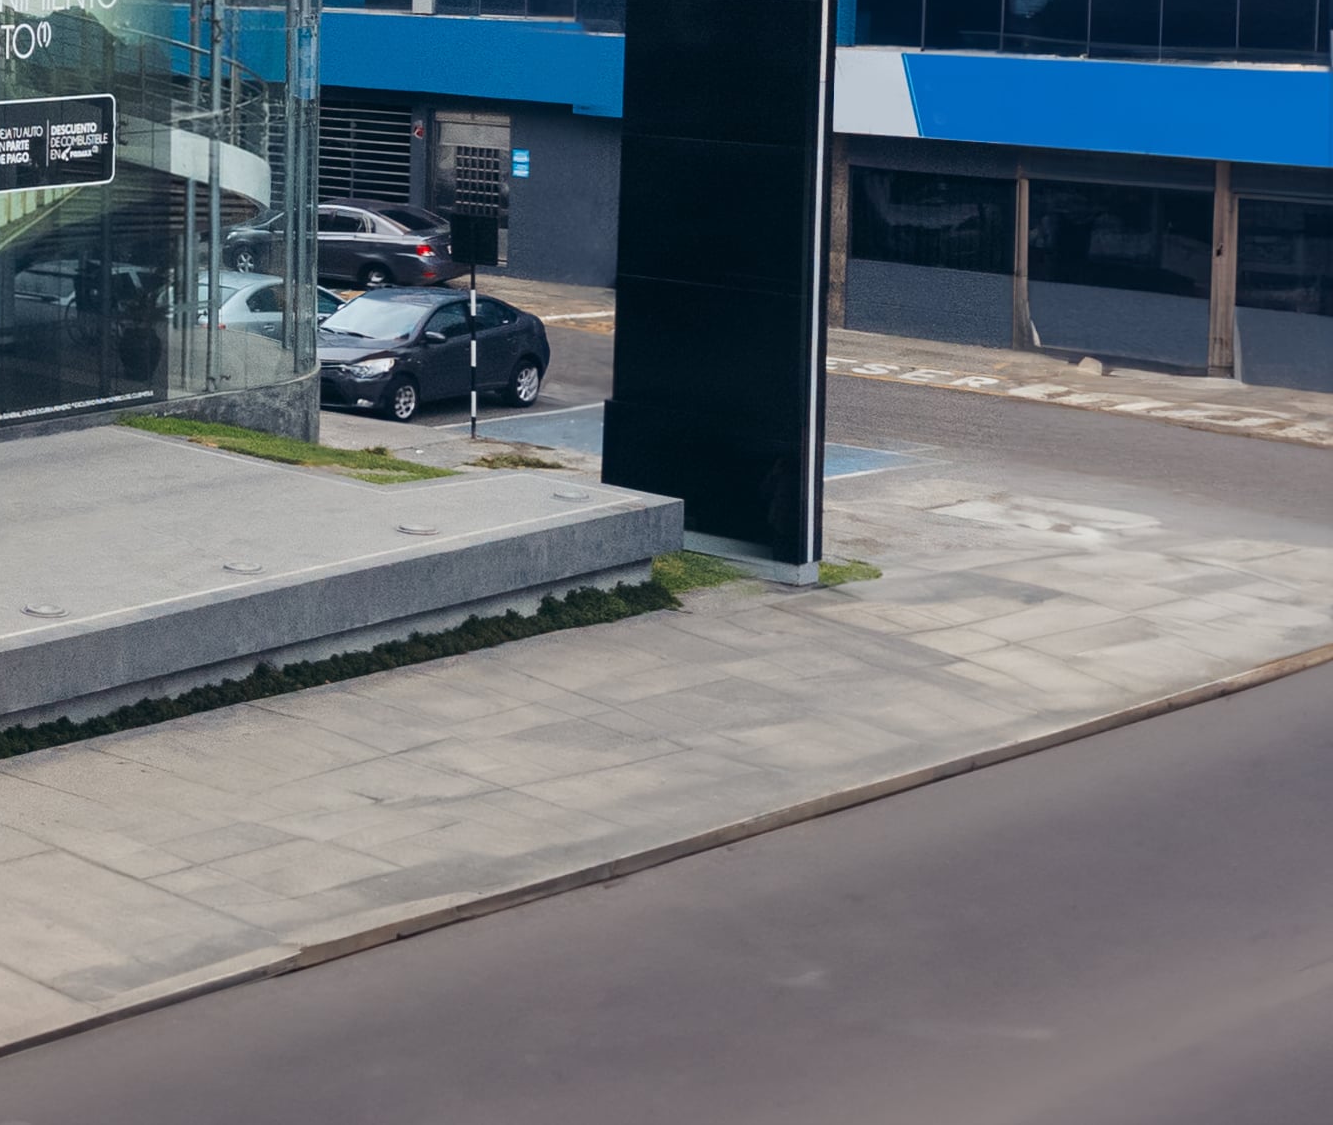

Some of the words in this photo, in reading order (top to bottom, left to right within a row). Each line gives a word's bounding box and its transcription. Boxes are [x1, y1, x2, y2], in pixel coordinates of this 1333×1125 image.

[50, 122, 98, 135] DESCUENTO
[6, 139, 30, 151] PARTE
[50, 136, 61, 148] DE
[50, 148, 61, 160] EN
